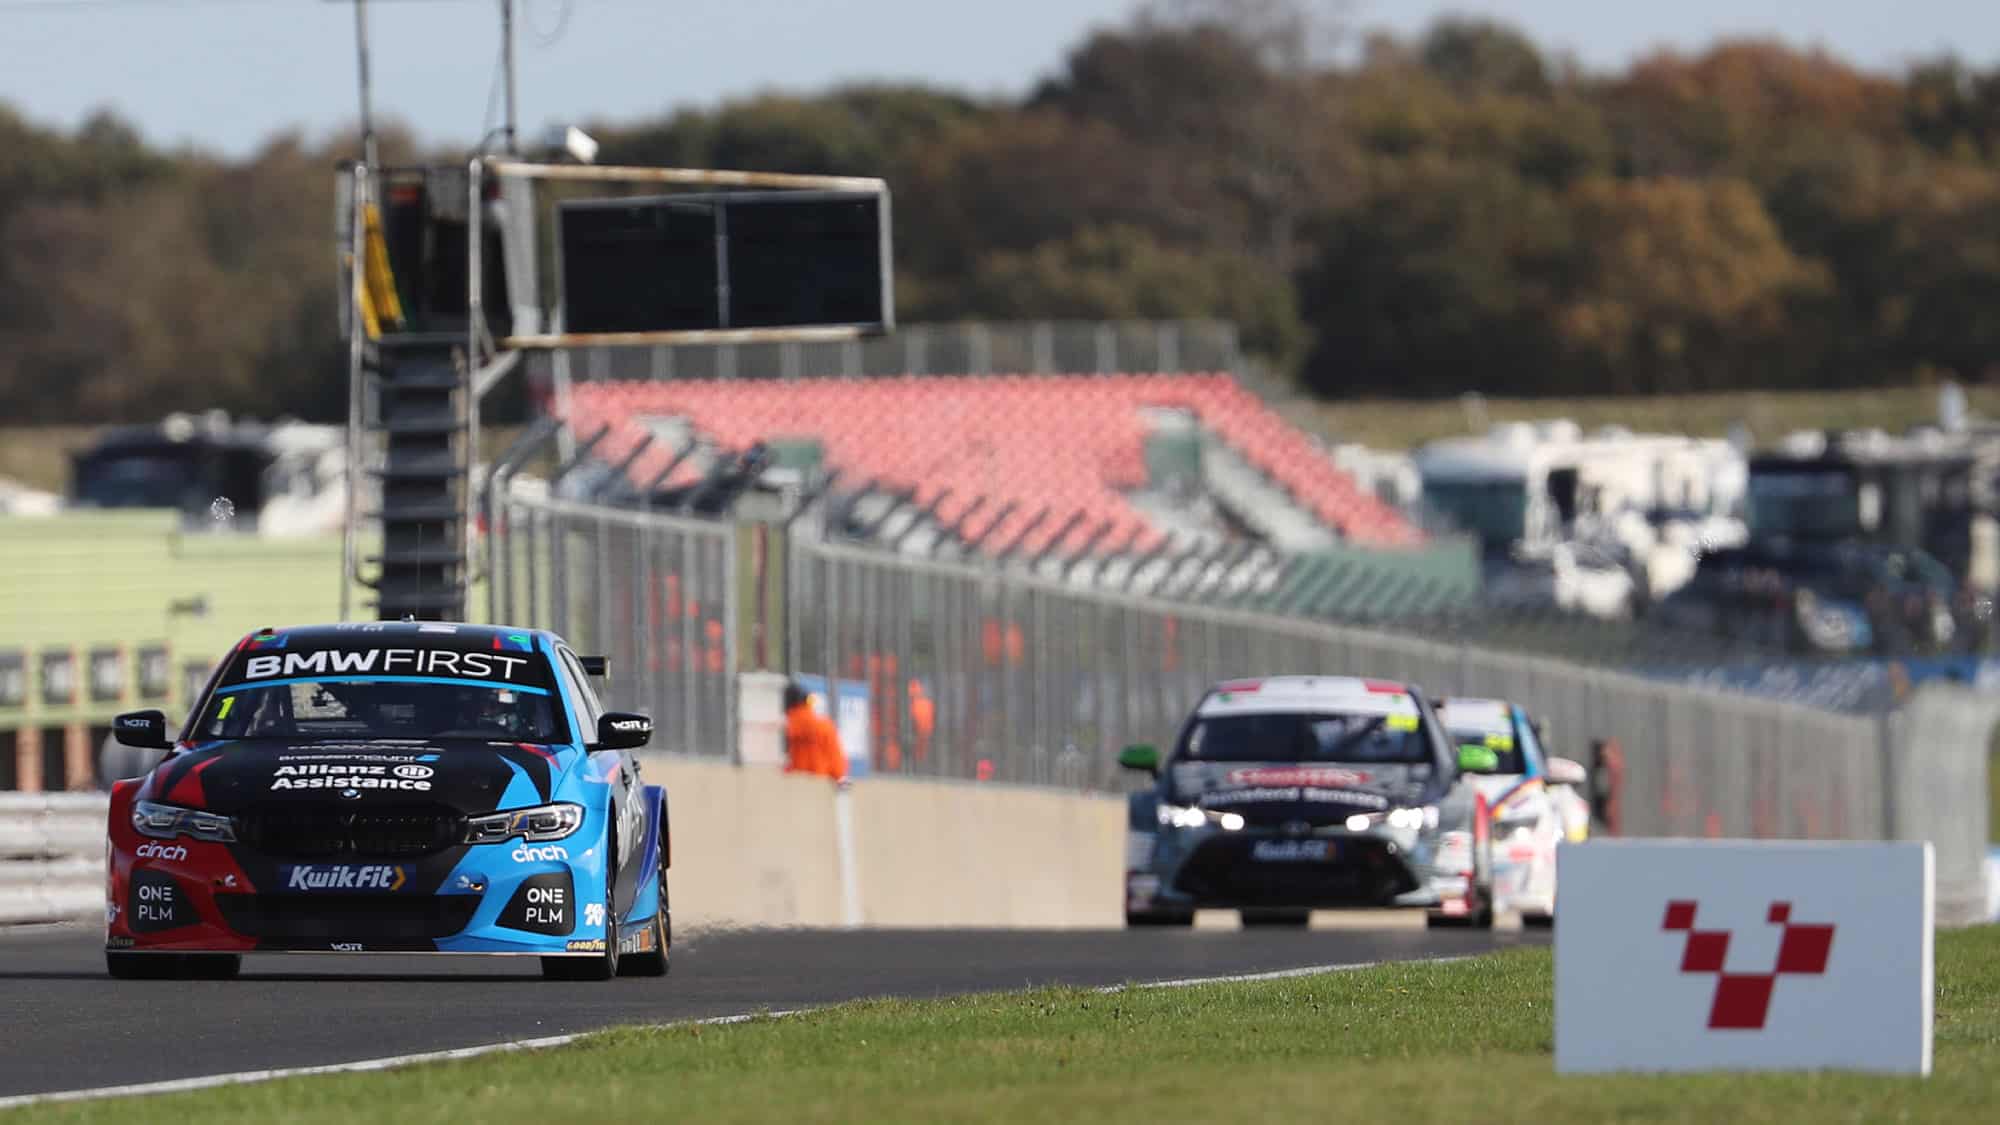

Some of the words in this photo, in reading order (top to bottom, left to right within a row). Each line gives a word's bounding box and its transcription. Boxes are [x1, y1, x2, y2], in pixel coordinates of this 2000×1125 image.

[216, 696, 235, 720] 1
[273, 764, 386, 777] Allianz
[270, 776, 432, 791] Assistance
[136, 840, 187, 861] cinch
[511, 842, 569, 863] cinch
[138, 885, 173, 901] ONE
[527, 887, 564, 904] ONE
[137, 904, 173, 921] PLM
[525, 907, 563, 924] PLM
